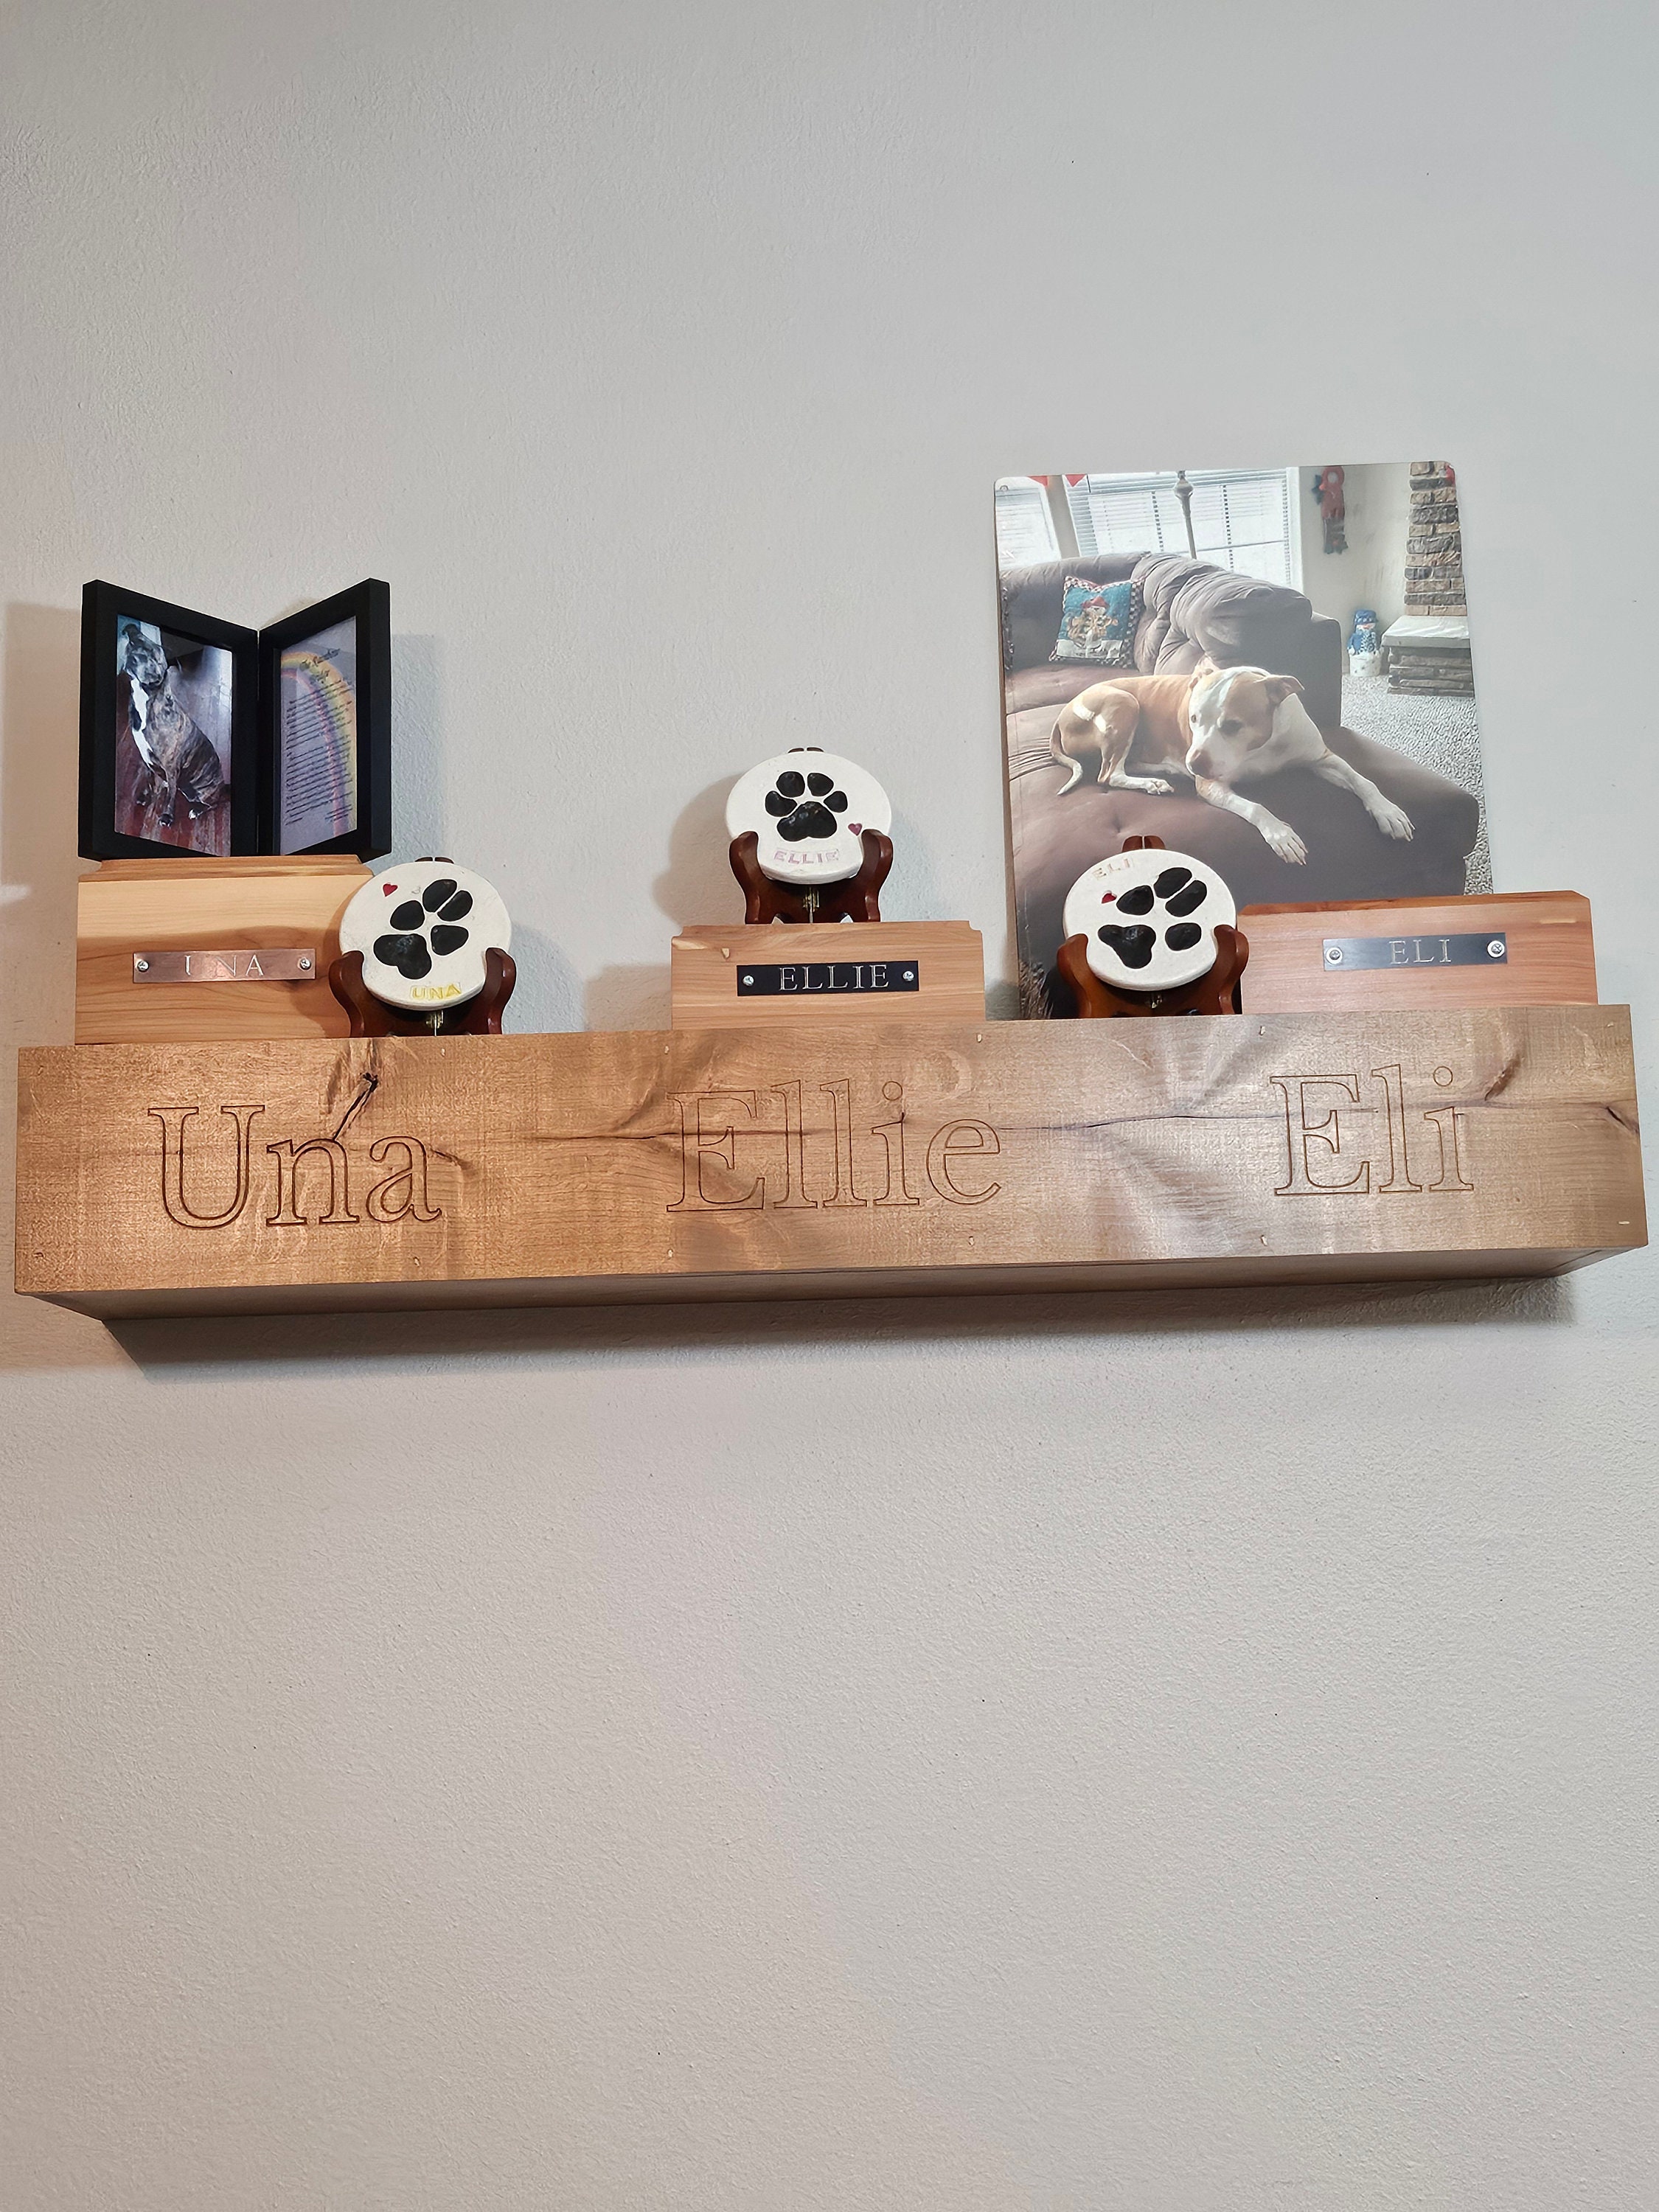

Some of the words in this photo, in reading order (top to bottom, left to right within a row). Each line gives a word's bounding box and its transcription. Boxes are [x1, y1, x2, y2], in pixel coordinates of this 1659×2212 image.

[773, 849, 839, 865] ELLIE
[1091, 858, 1130, 881] ELI
[1388, 939, 1452, 964] ELI
[779, 964, 889, 991] ELLIE
[411, 983, 462, 1000] UNA
[1270, 1063, 1474, 1196] Eli
[667, 1078, 1001, 1212] Ellie
[148, 1104, 442, 1228] Una
